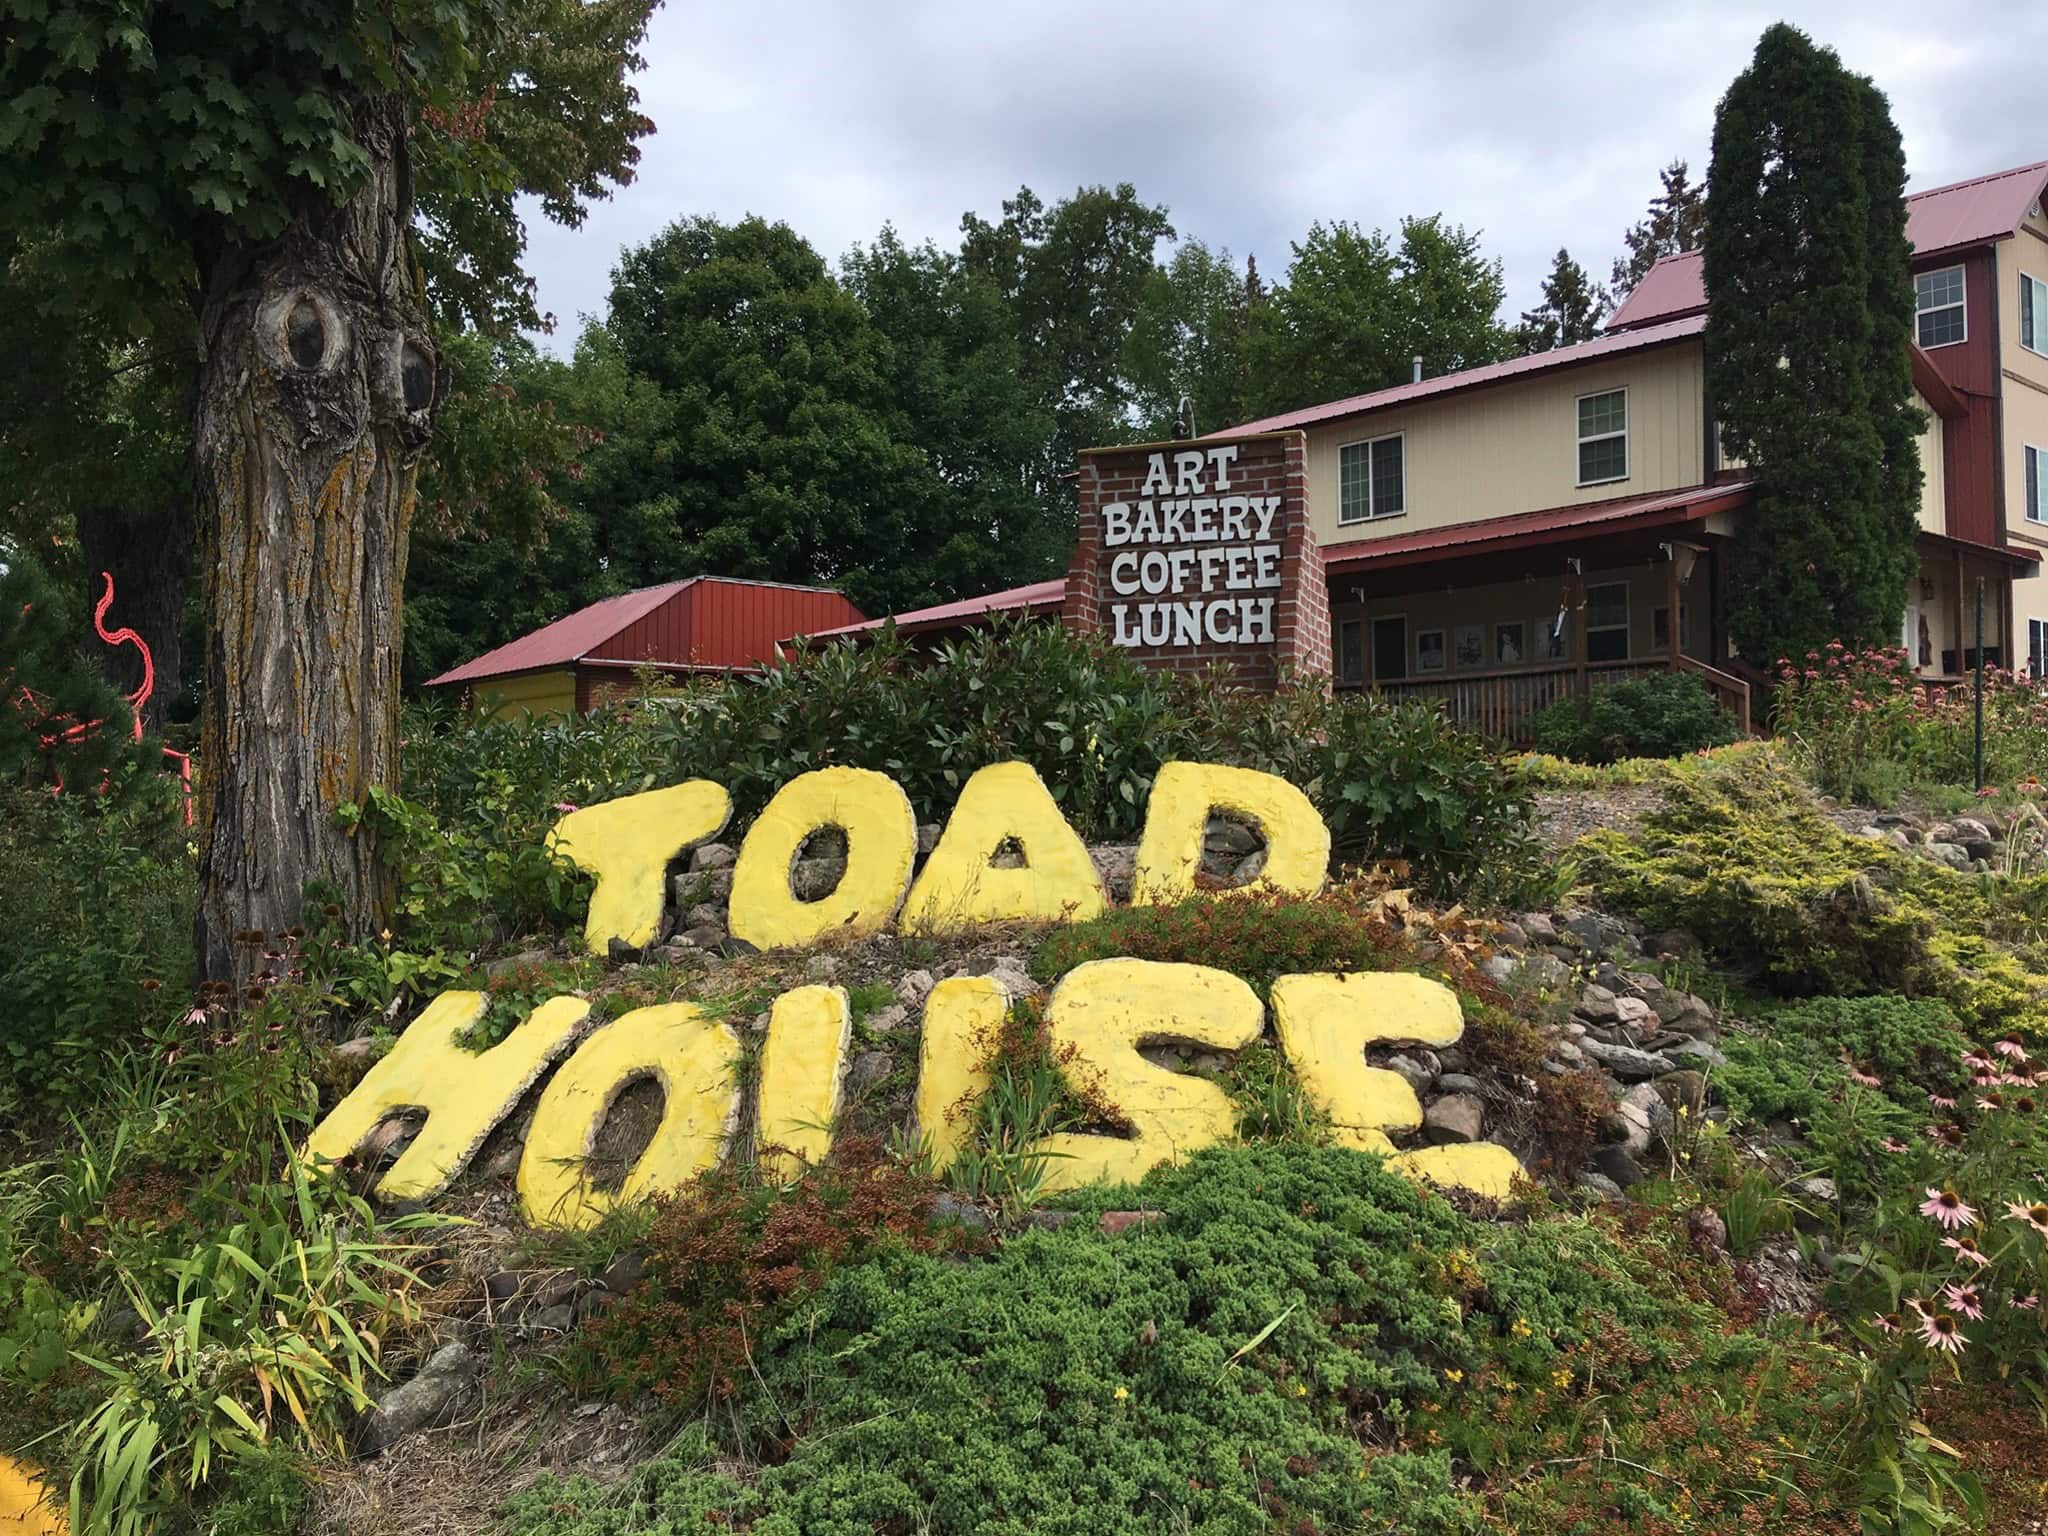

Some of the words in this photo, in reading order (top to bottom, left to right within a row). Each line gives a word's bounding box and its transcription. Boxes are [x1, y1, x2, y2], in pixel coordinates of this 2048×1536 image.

[1141, 445, 1238, 496] ART
[1102, 496, 1281, 546] BAKERY
[1110, 545, 1281, 596] COFFEE
[1112, 598, 1275, 648] LUNCH
[544, 761, 1332, 955] TOAD
[288, 957, 1527, 1230] HOUSE
